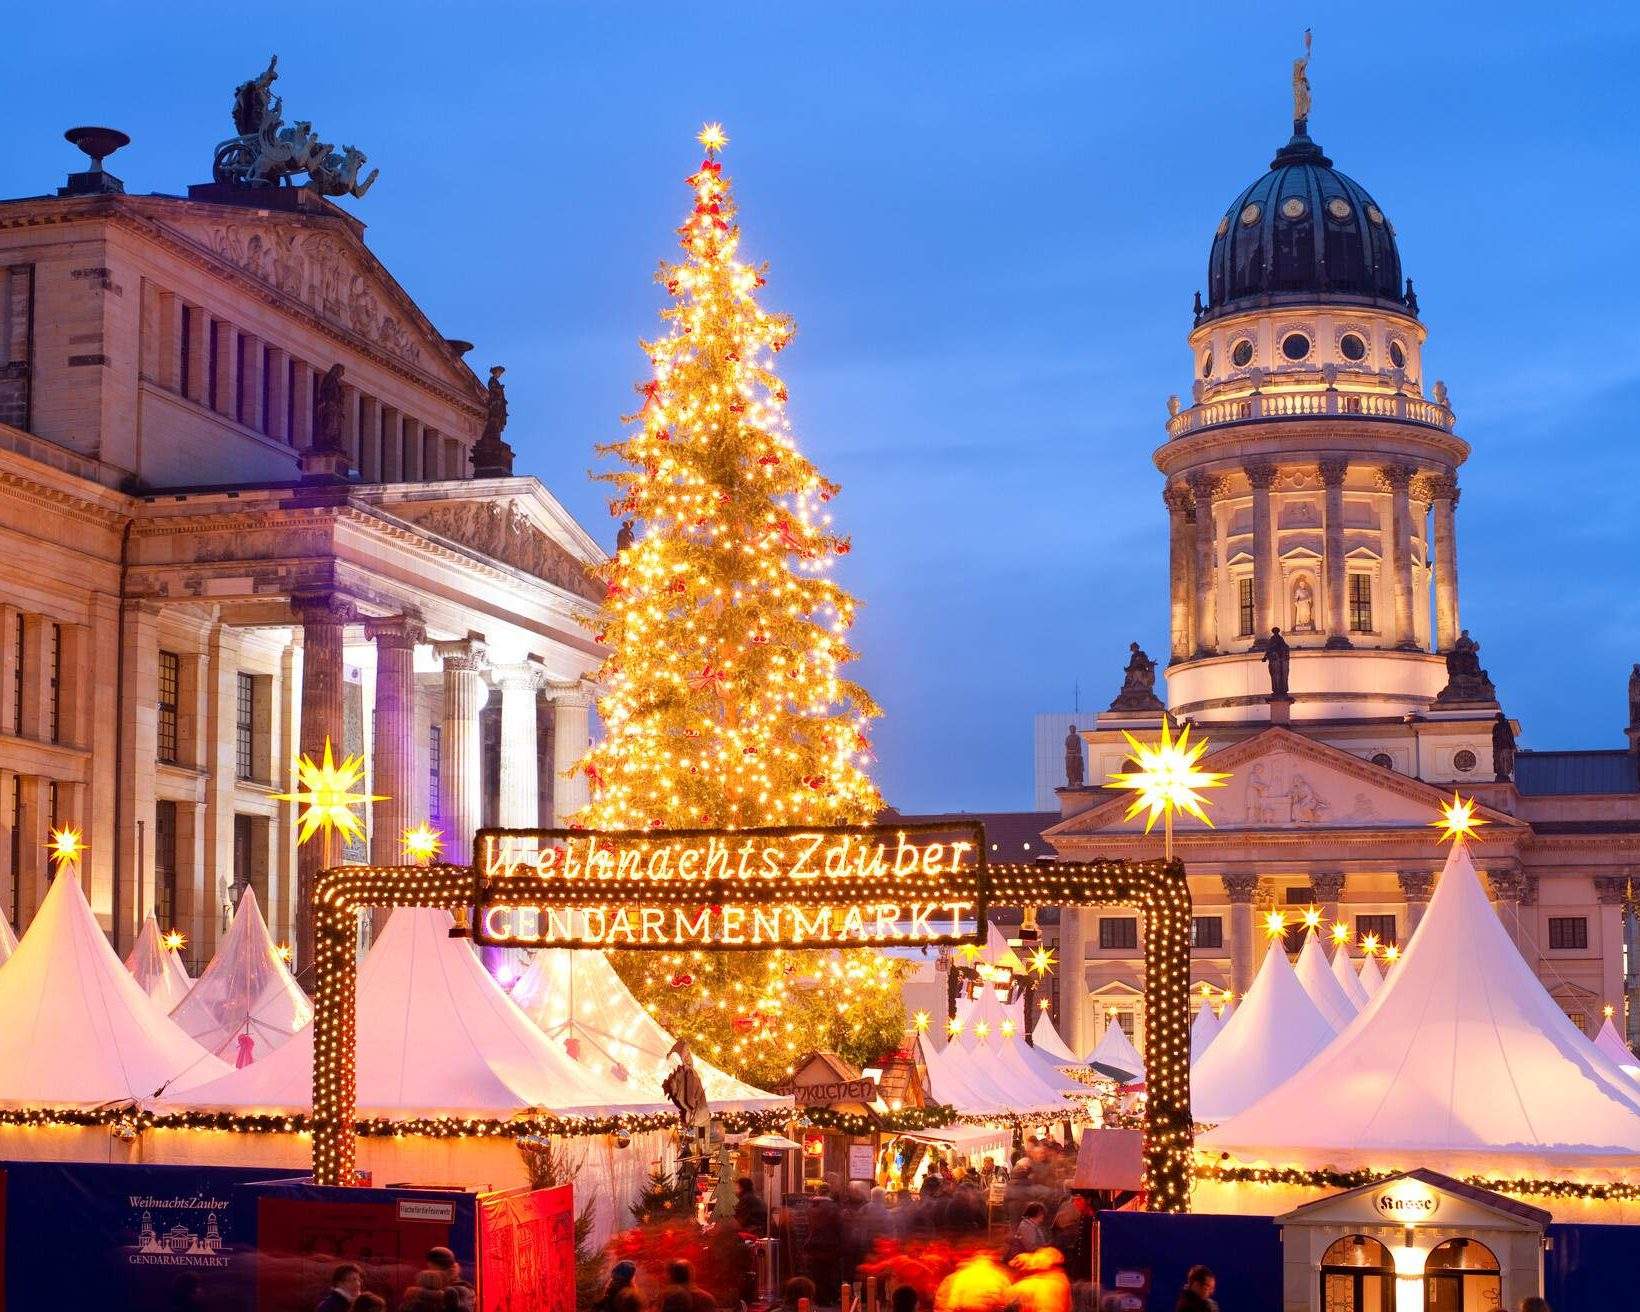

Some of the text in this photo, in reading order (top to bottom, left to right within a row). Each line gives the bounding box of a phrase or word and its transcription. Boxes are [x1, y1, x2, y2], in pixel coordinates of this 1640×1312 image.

[484, 830, 972, 881] WeihnachtsZauber
[485, 902, 972, 945] GENDARMENMARKT
[129, 1195, 230, 1209] WeihnachtsZauber
[1380, 1195, 1432, 1210] Kasse
[129, 1254, 230, 1267] GENDARMENMARKT
